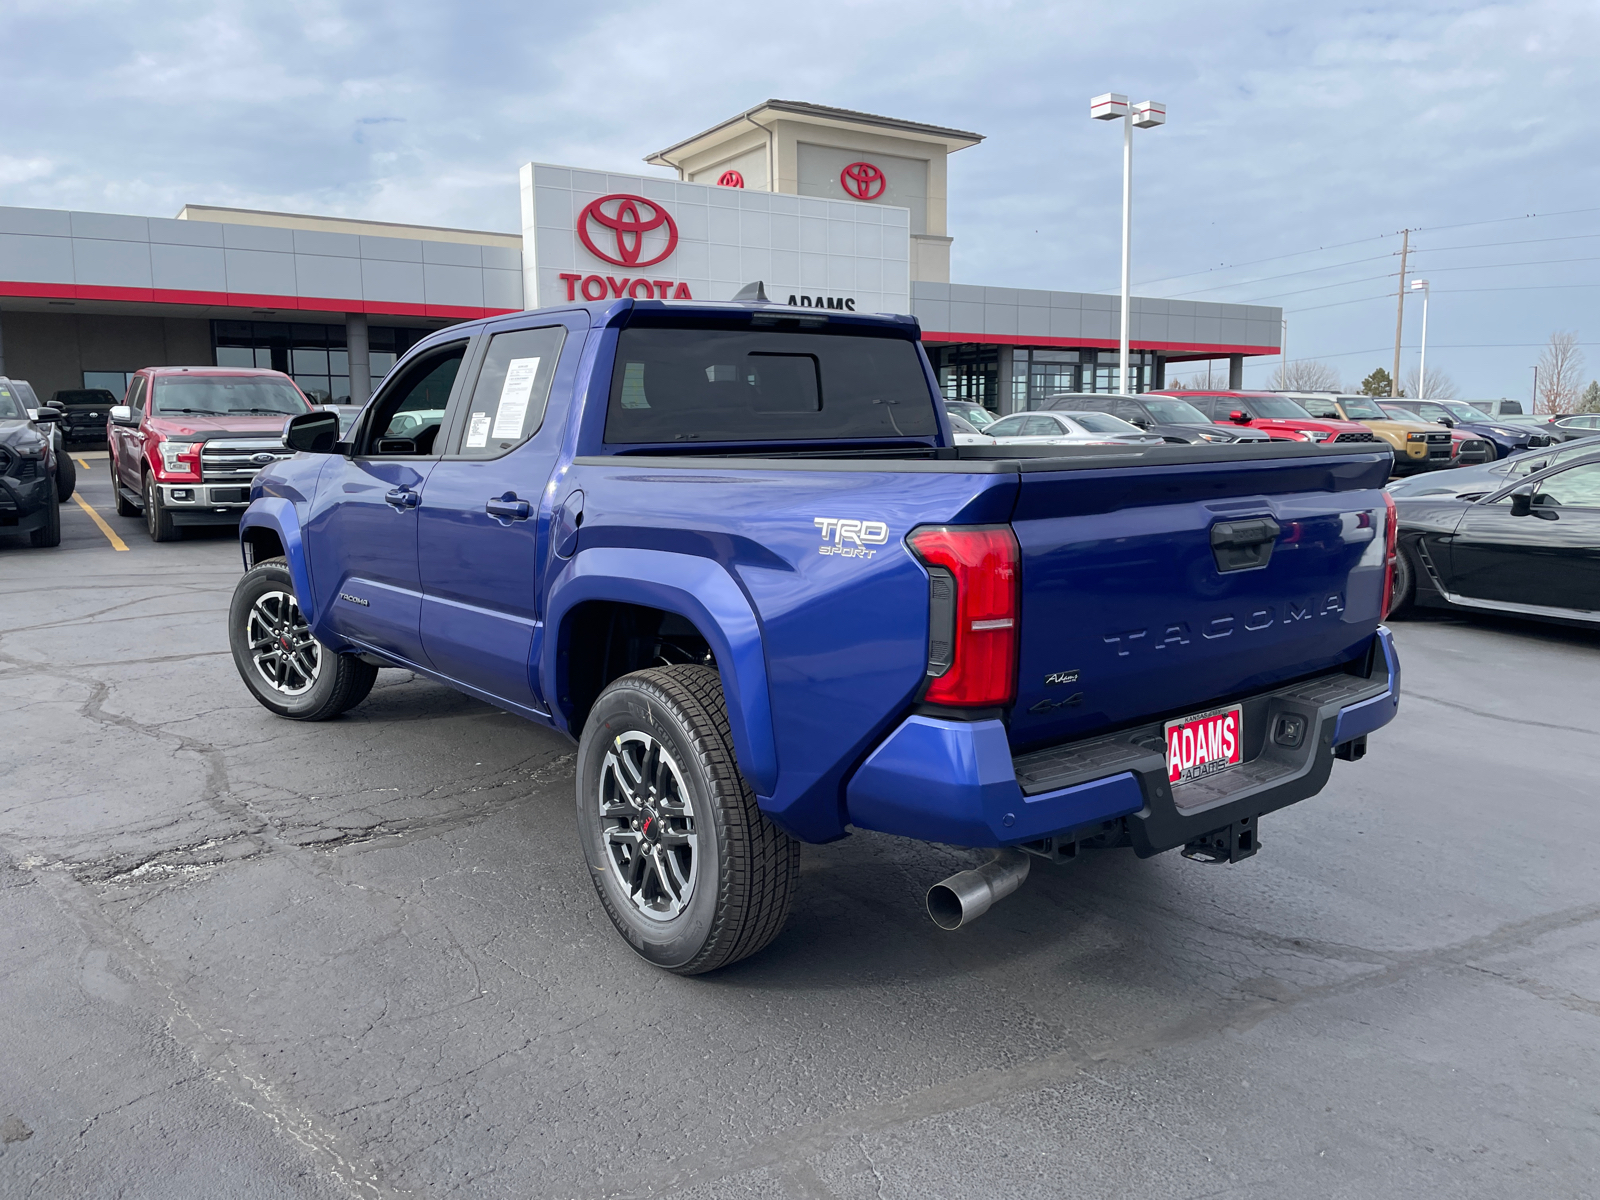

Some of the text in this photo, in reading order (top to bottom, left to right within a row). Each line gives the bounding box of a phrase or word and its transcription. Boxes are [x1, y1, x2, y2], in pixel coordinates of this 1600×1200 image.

[559, 273, 693, 301] TOYOTA
[788, 295, 856, 311] ADAMS
[814, 517, 889, 549] TRD
[819, 546, 876, 559] SPORT
[339, 592, 370, 607] TACOMA
[1103, 591, 1345, 656] TACOMA
[1184, 712, 1208, 723] KANSAS
[1169, 716, 1235, 776] ADAMS
[1184, 759, 1227, 781] ADAMS
